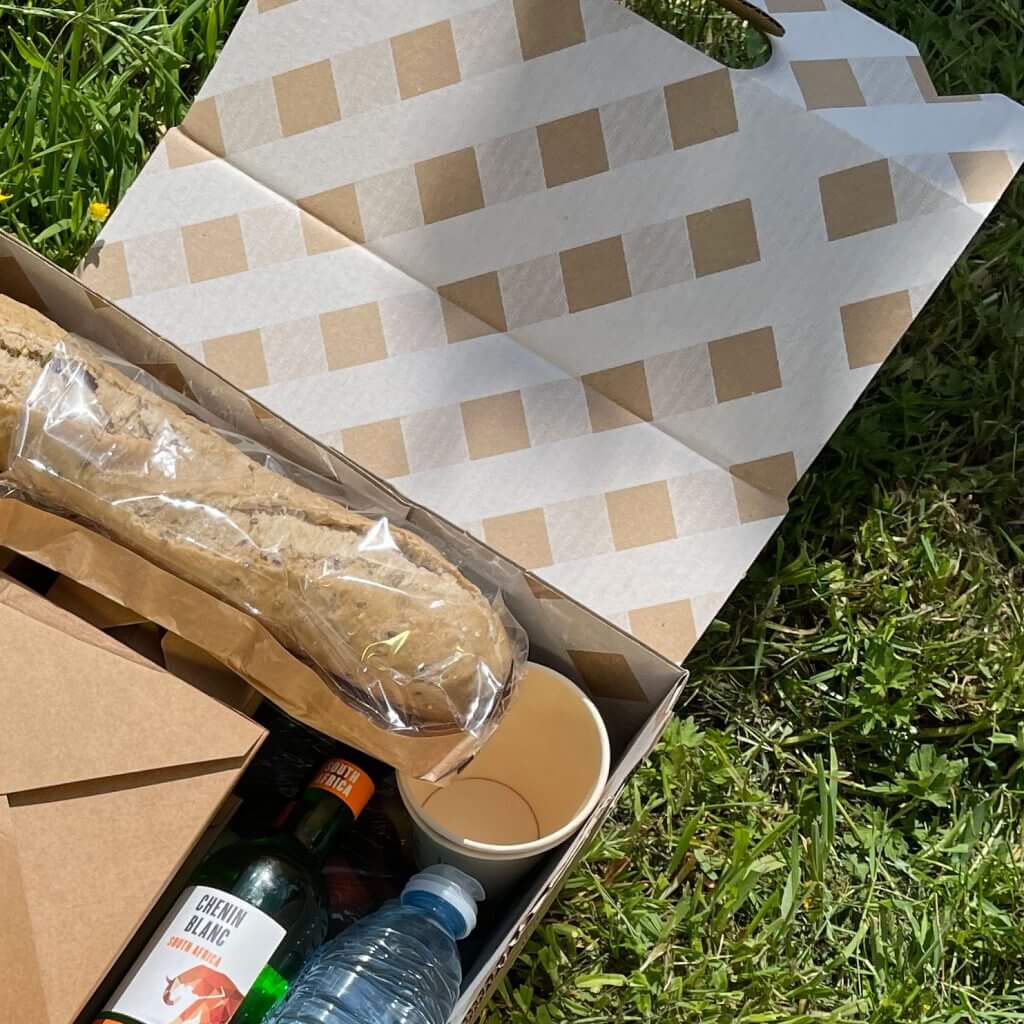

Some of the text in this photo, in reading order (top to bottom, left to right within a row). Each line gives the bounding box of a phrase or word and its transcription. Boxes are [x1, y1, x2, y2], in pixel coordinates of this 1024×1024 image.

[318, 773, 353, 798] FRICA
[195, 894, 247, 928] CHENIN
[184, 915, 230, 946] BLANC
[167, 936, 222, 968] SOUTH AFRICA
